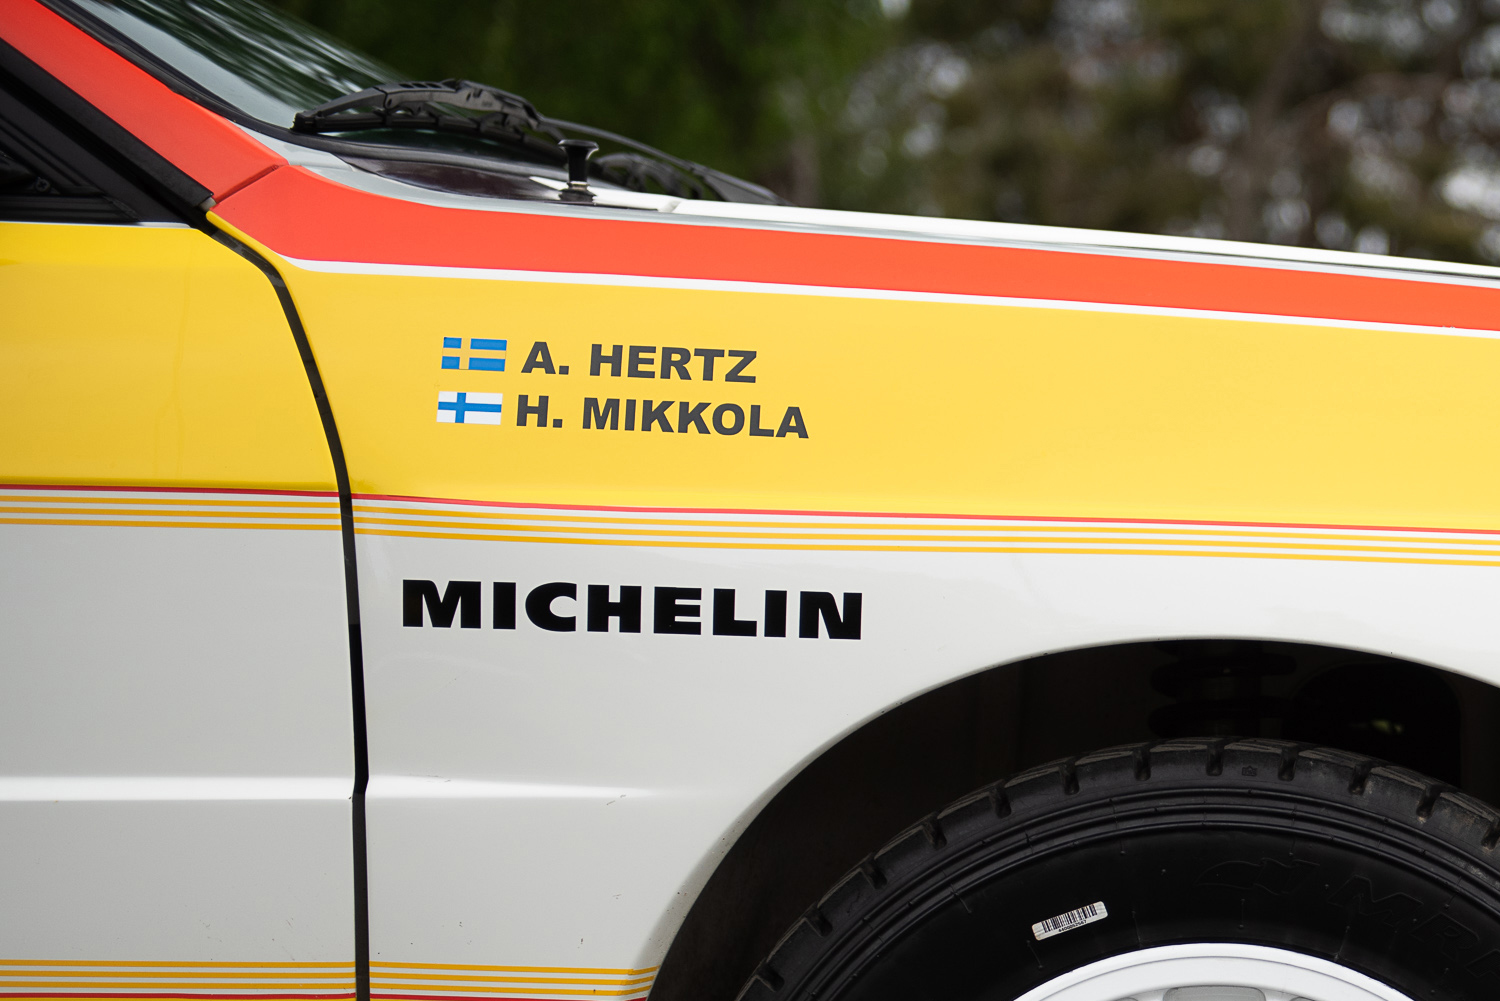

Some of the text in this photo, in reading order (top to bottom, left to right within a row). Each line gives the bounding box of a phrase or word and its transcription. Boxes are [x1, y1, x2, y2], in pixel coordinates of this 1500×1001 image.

[521, 341, 758, 384] A. HERTZ
[516, 394, 810, 439] H. MIKKOLA
[402, 579, 863, 640] MICHELIN
